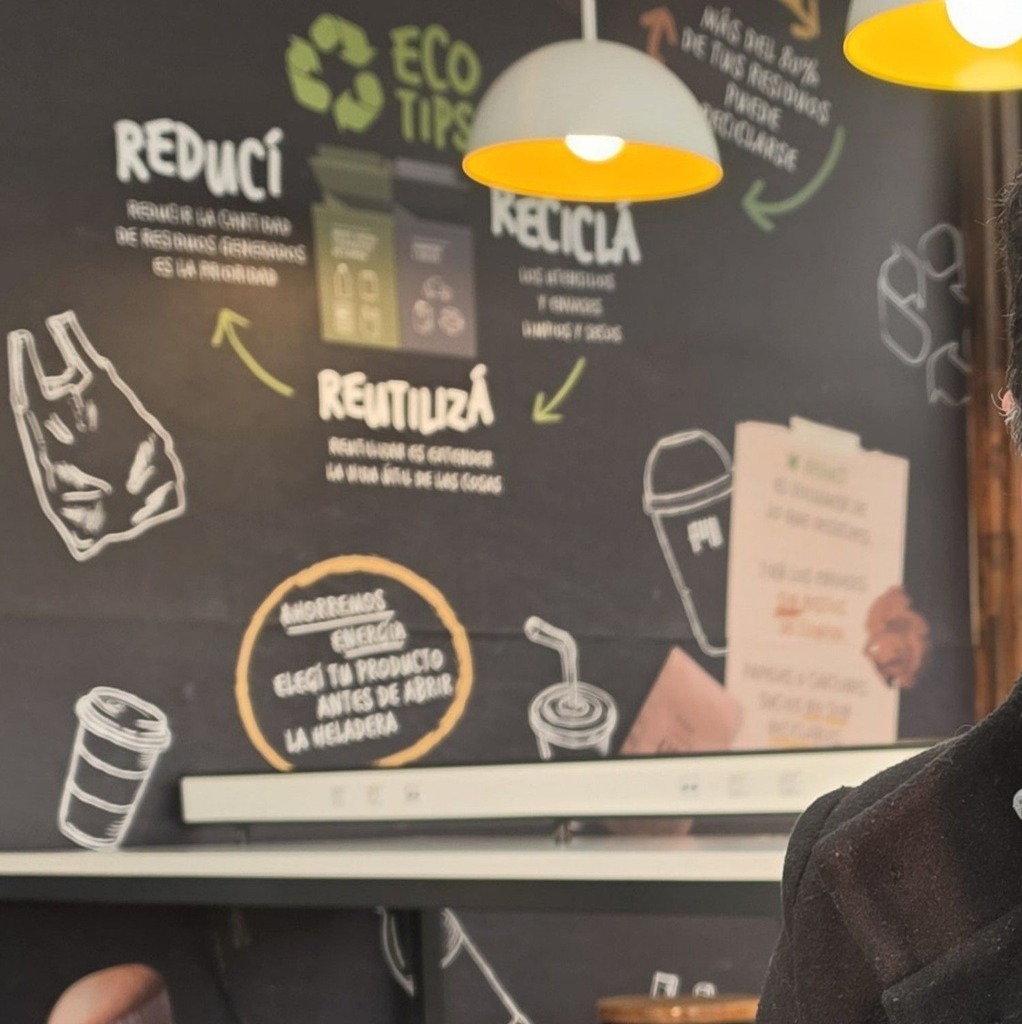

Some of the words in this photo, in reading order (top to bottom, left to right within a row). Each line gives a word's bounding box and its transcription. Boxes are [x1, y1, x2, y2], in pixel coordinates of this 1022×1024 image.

[390, 24, 481, 95] ECO
[394, 87, 474, 151] TIPS
[113, 117, 285, 202] REDUCÍ
[115, 225, 139, 247] DE
[490, 187, 642, 266] RECICLÁ
[318, 363, 495, 435] REUTILIZÁ
[279, 588, 388, 626] AHORREMOS
[354, 647, 445, 685] PRODUCTO
[317, 686, 374, 720] ANTES
[376, 683, 401, 709] DE
[284, 727, 310, 754] LA
[311, 710, 399, 748] HELADERA
